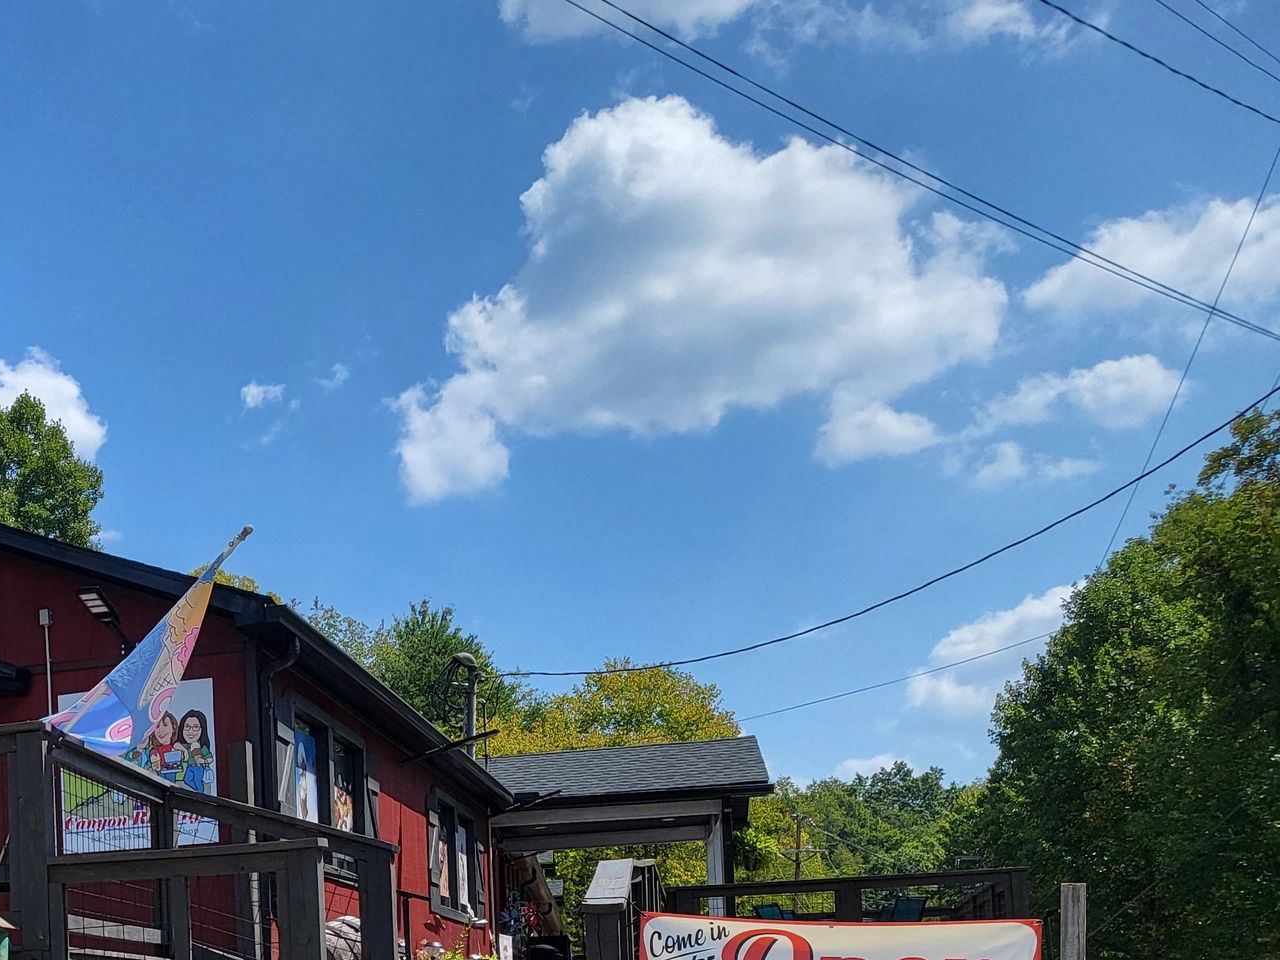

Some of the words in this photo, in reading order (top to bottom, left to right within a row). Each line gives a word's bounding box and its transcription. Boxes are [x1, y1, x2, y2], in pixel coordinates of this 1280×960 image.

[65, 815, 129, 832] Canyon
[649, 928, 707, 958] Come
[708, 921, 730, 941] in
